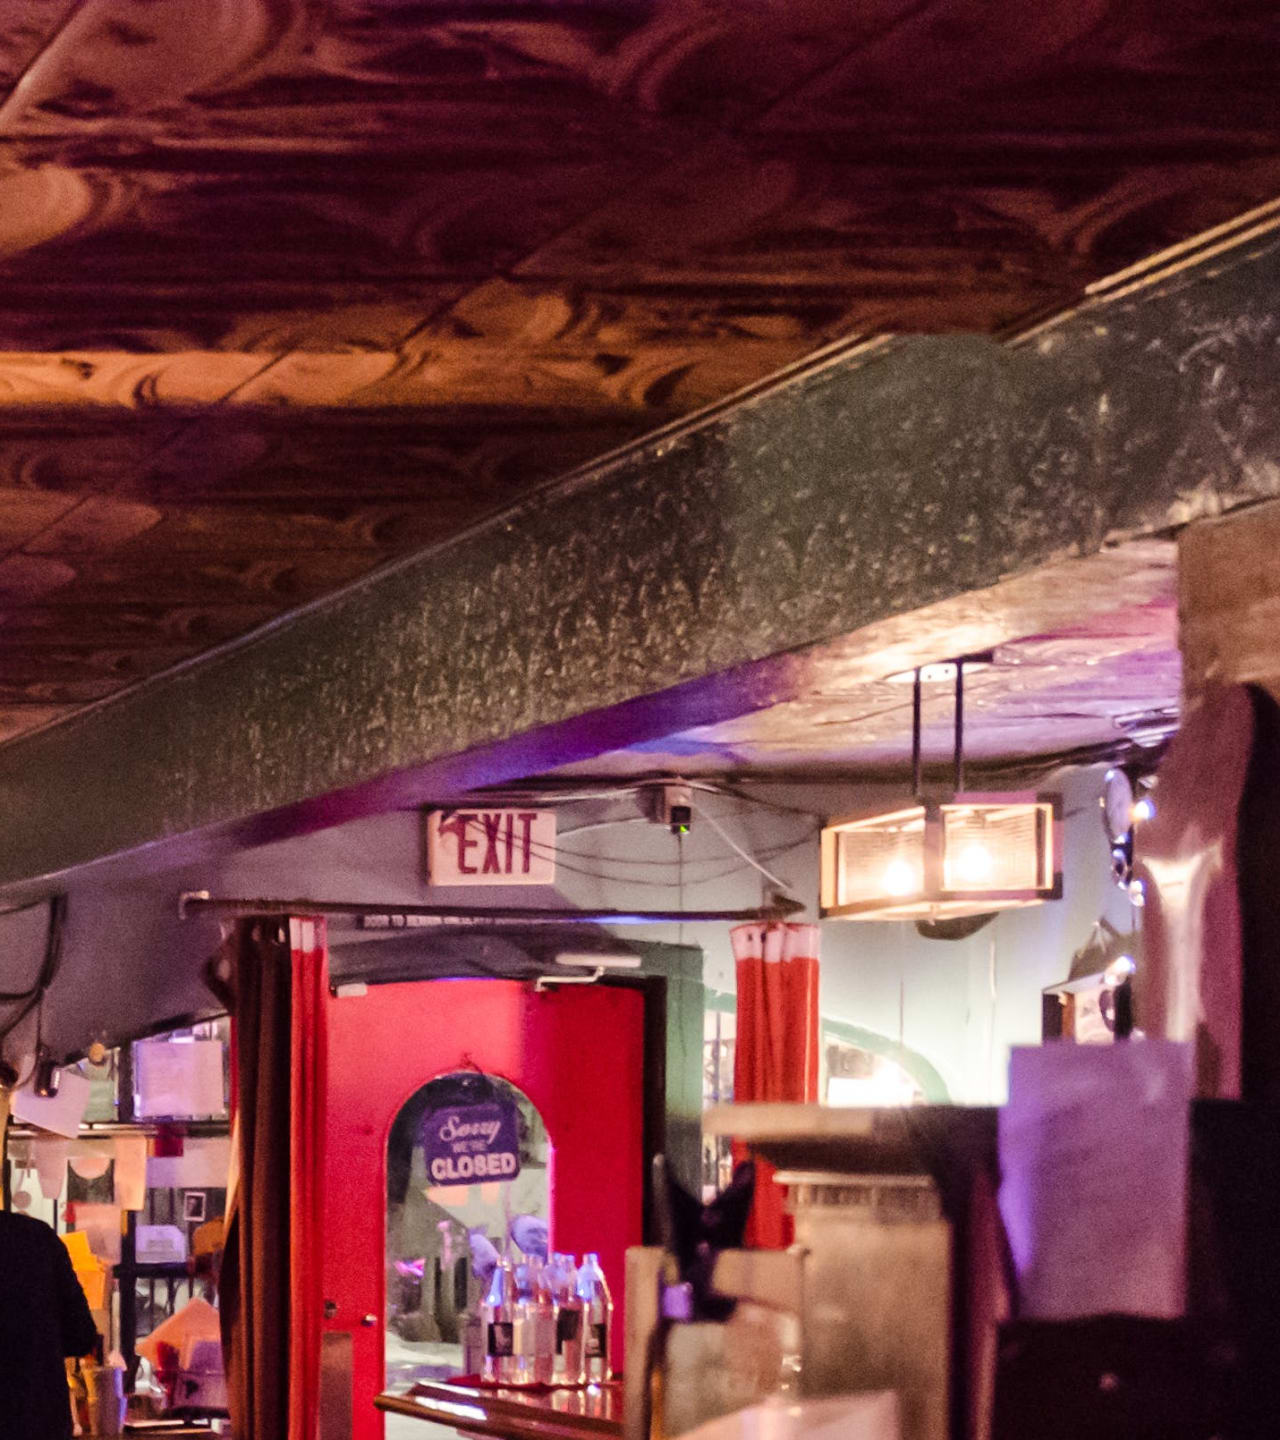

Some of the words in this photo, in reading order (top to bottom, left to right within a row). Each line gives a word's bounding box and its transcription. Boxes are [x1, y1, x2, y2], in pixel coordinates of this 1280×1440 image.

[458, 813, 537, 874] EXIT
[440, 1115, 501, 1145] Sorry
[431, 1152, 516, 1180] CLOSED
